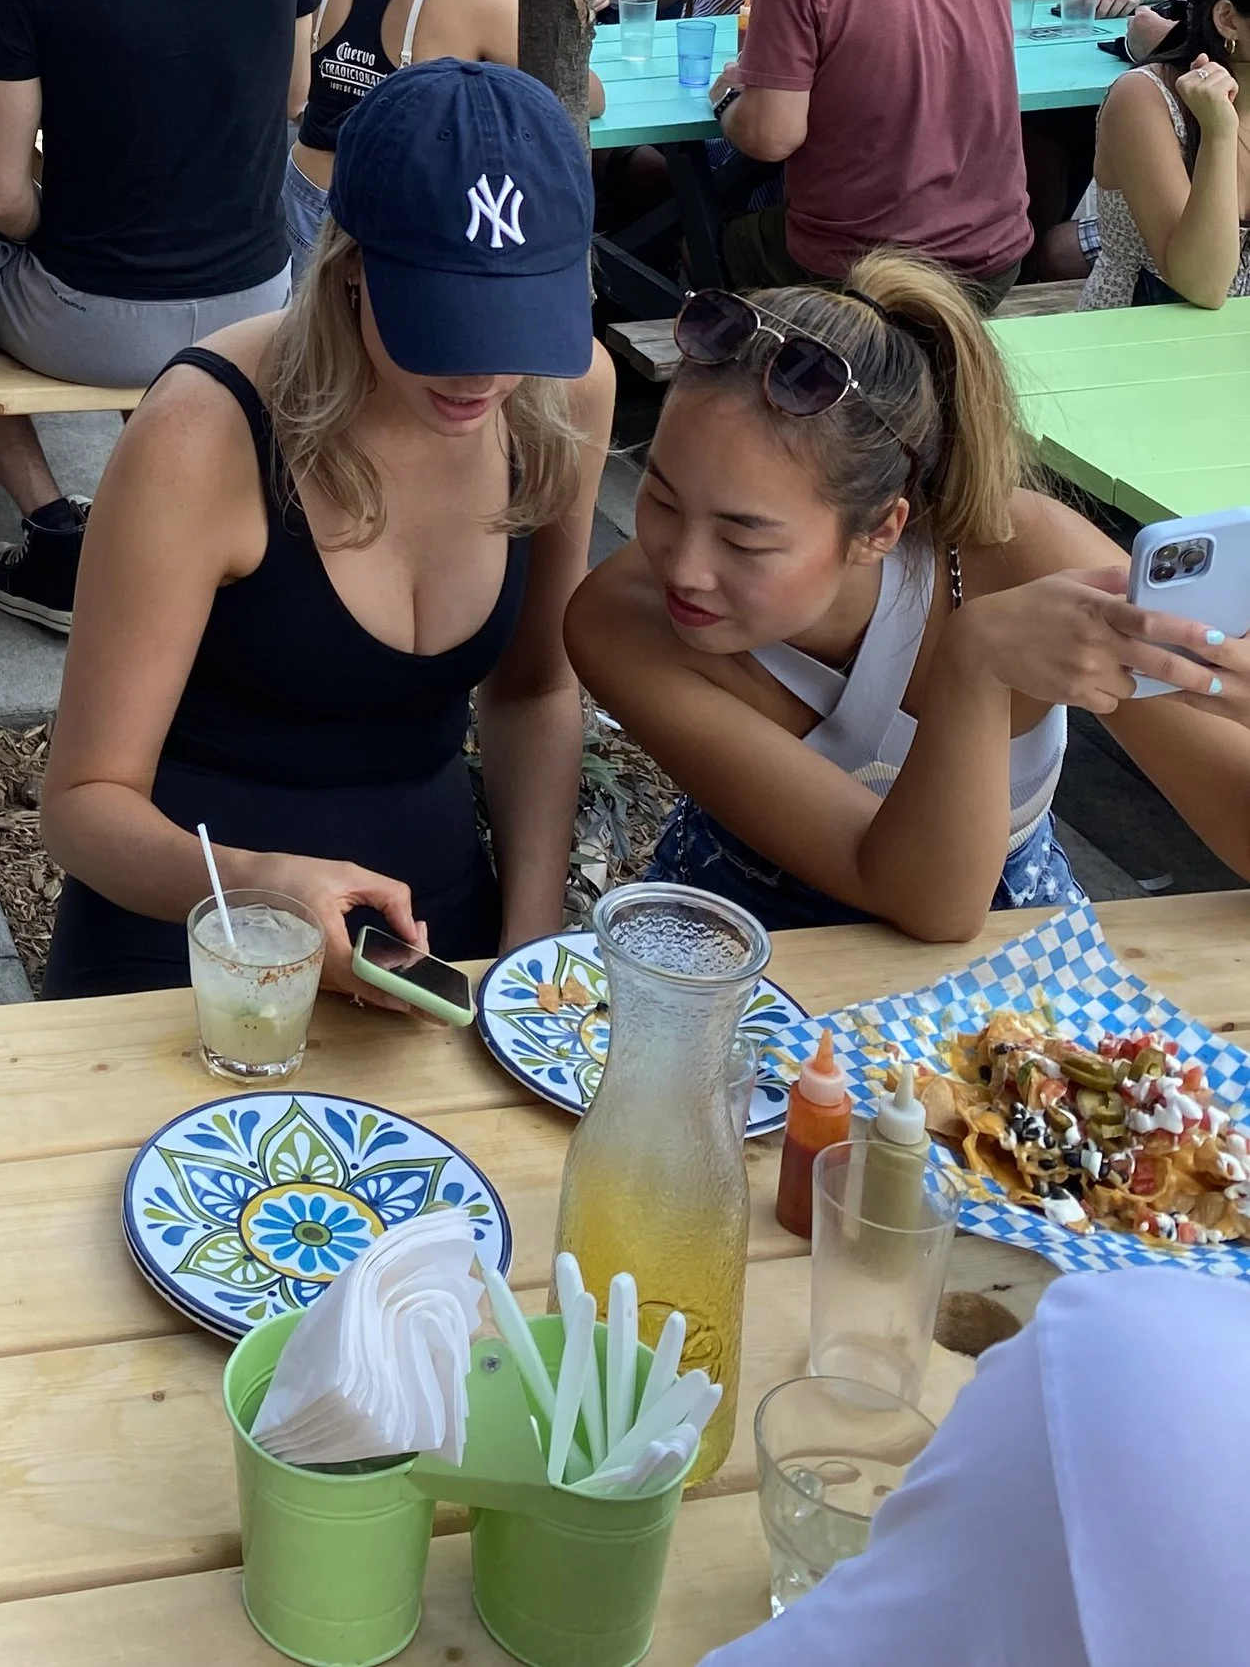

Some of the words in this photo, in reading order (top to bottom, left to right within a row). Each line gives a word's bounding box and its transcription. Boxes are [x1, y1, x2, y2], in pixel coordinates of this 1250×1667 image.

[336, 41, 376, 67] Cuervo
[352, 87, 367, 97] AGA
[466, 174, 526, 248] NY
[58, 295, 87, 312] ARMOUR
